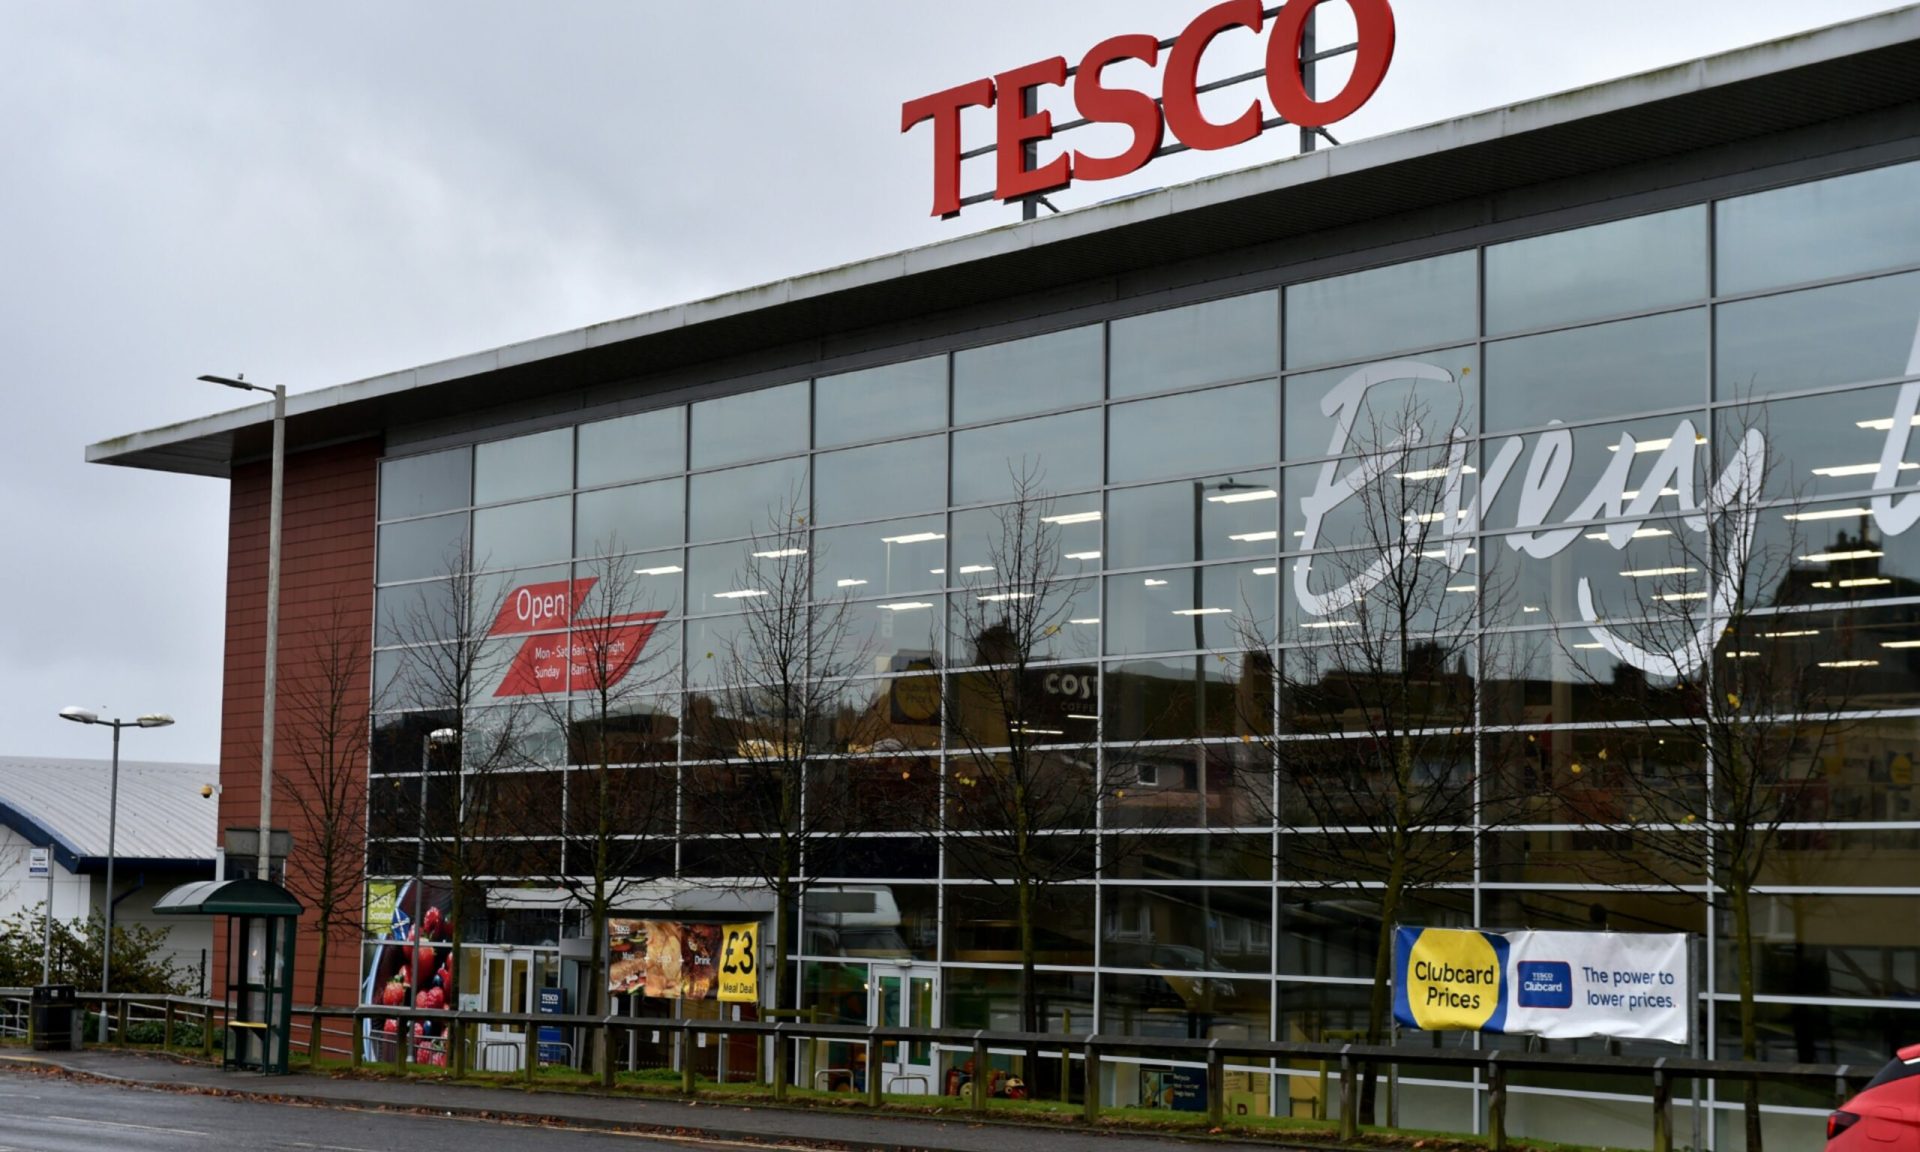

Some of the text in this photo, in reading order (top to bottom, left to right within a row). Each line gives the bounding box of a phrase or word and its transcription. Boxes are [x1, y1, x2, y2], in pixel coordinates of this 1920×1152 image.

[901, 0, 1396, 220] TESCO
[1294, 360, 1766, 677] Every
[516, 589, 565, 626] Open
[535, 647, 550, 660] Mon
[534, 665, 560, 680] Sunday
[694, 955, 711, 966] Drink
[723, 931, 754, 975] £3
[1415, 961, 1494, 985] Clubcard
[1582, 966, 1674, 987] The power to
[541, 993, 559, 1001] TESCO
[723, 983, 755, 994] Meal Deal
[1524, 981, 1563, 992] Clubcard
[1426, 987, 1480, 1009] Prices
[1587, 990, 1677, 1011] lower prices.
